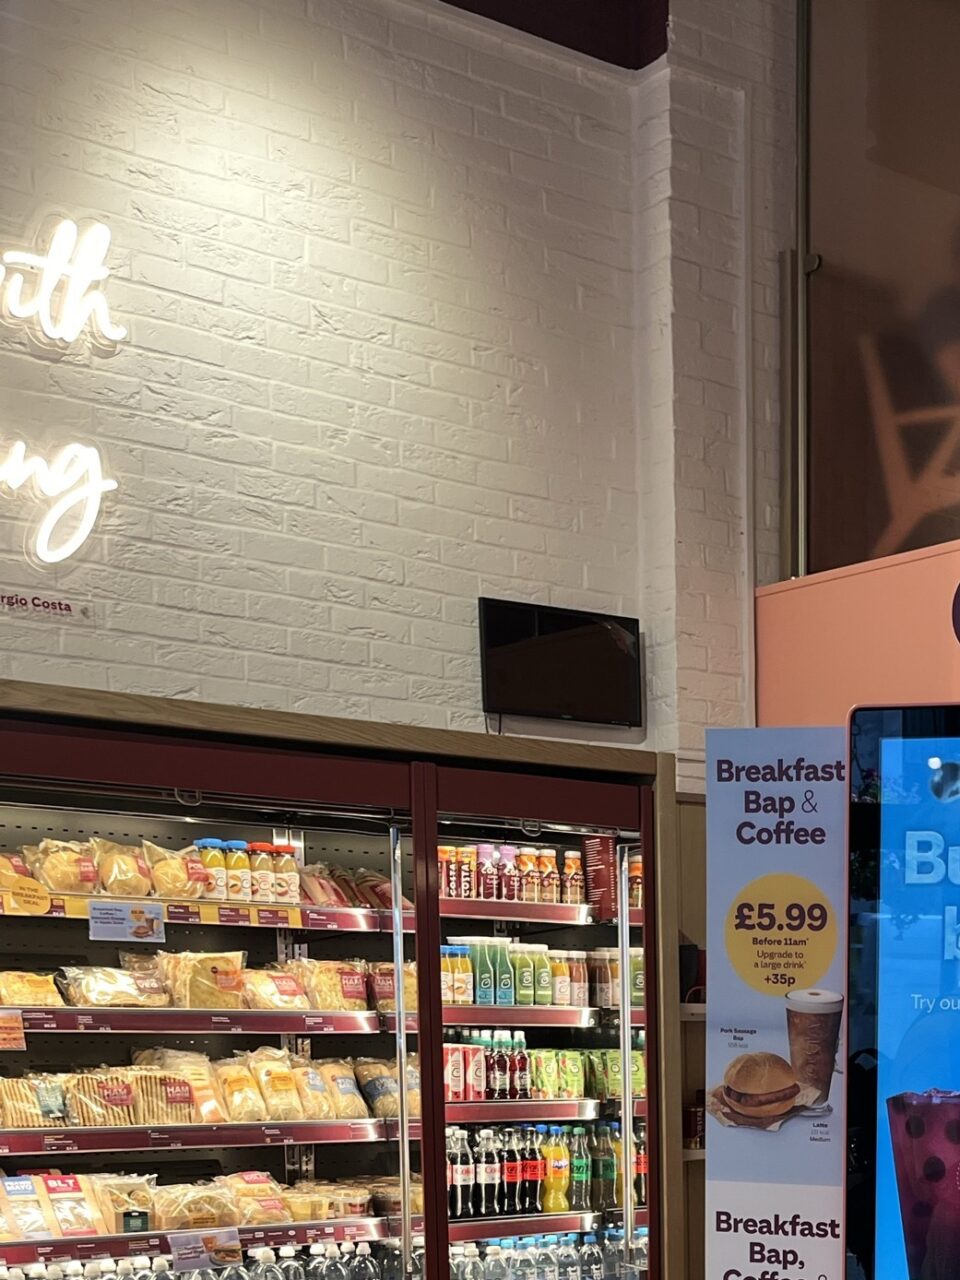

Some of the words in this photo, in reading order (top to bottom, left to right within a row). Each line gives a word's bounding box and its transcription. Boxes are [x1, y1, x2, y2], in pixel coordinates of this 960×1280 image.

[0, 219, 128, 342] ith
[31, 597, 72, 612] Costa
[716, 757, 845, 782] Breakfast
[744, 790, 796, 818] Bap
[801, 789, 818, 813] &
[736, 820, 826, 845] Coffee
[734, 902, 828, 931] £5.99
[752, 937, 782, 946] Before
[756, 950, 793, 960] Upgrade
[794, 951, 804, 959] to
[760, 961, 782, 970] large
[764, 974, 796, 987] +35p
[911, 994, 936, 1013] Try
[47, 1179, 75, 1188] BLT
[715, 1211, 840, 1239] Breakfast
[749, 1242, 805, 1270] Bap,
